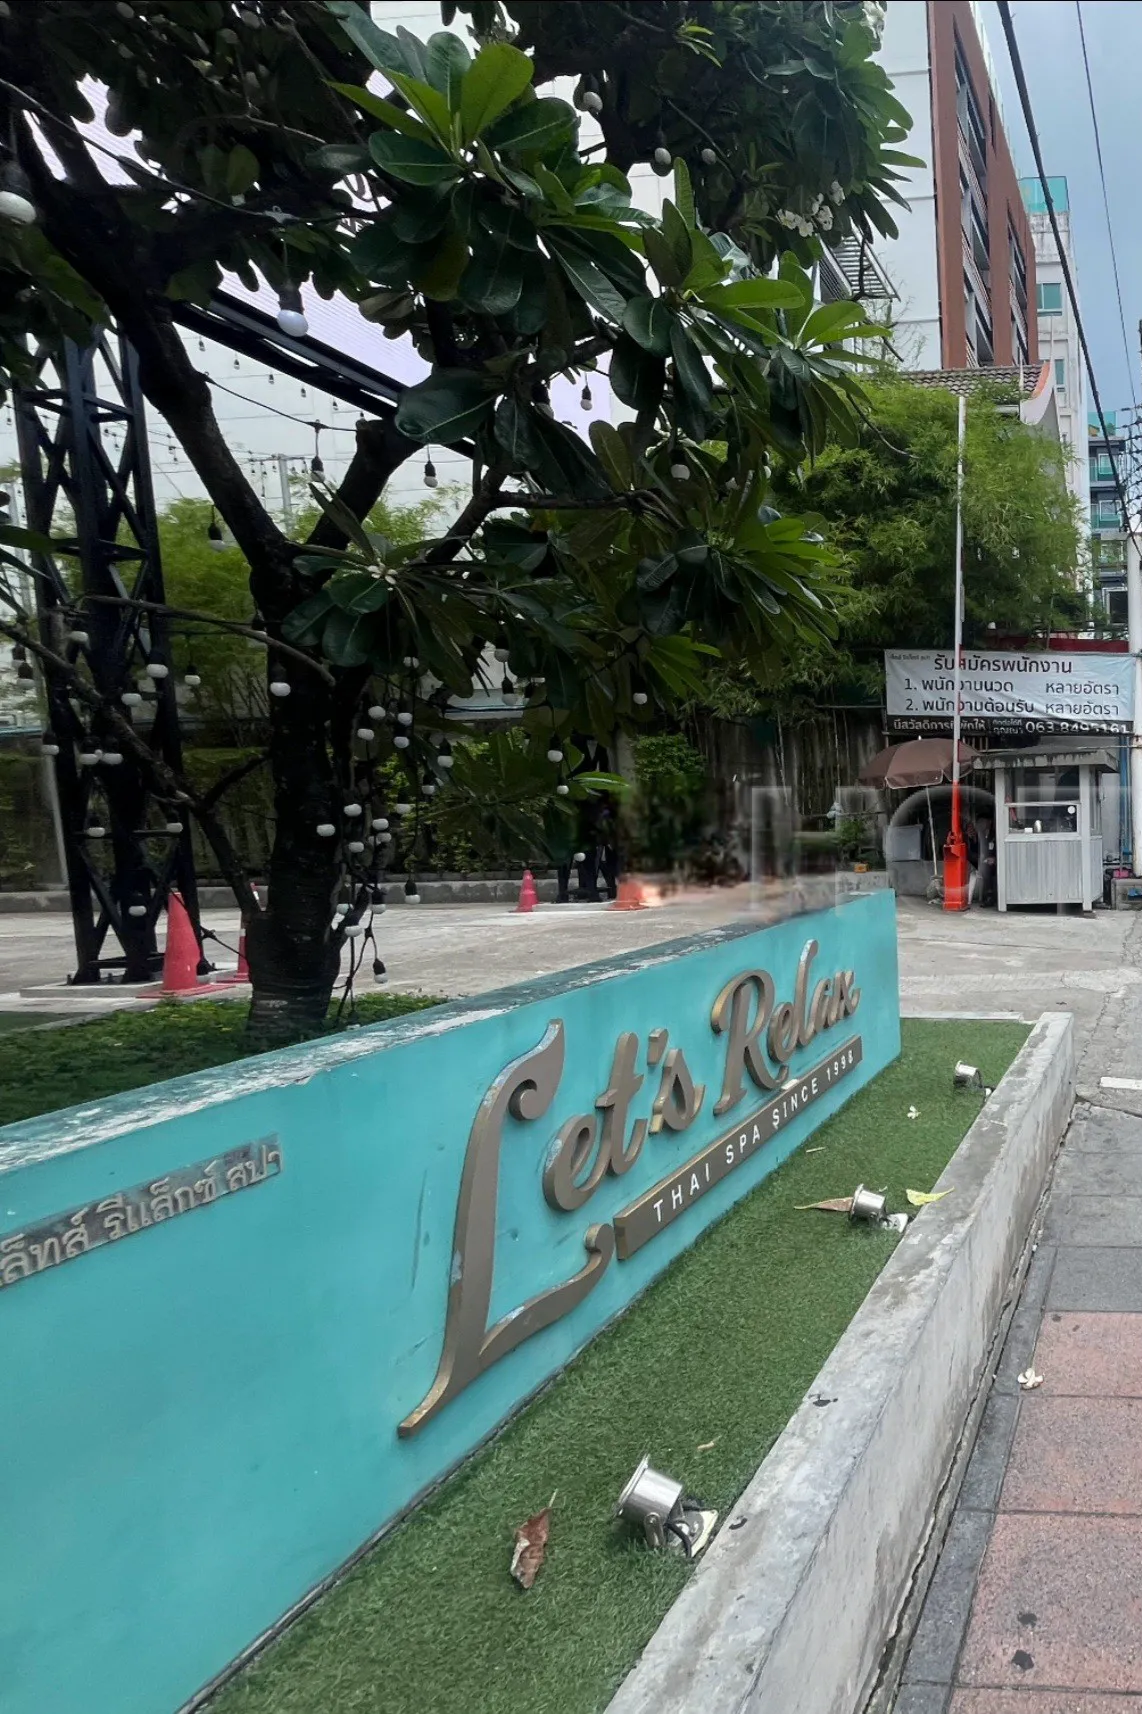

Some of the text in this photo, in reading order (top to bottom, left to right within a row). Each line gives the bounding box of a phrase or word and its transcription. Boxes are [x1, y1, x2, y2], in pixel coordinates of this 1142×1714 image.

[905, 678, 917, 690] 1.
[1045, 681, 1119, 695] หลายอัตรา
[934, 654, 1072, 673] รับสมัครพนักงาน
[905, 698, 918, 711] 2.
[1045, 701, 1119, 715] หลายอัตรา
[653, 1050, 855, 1223] THAI SPA SINCE 1998
[0, 1207, 89, 1288] ล็ทส์
[225, 1144, 283, 1192] สปา
[397, 938, 861, 1437] Let's Relax
